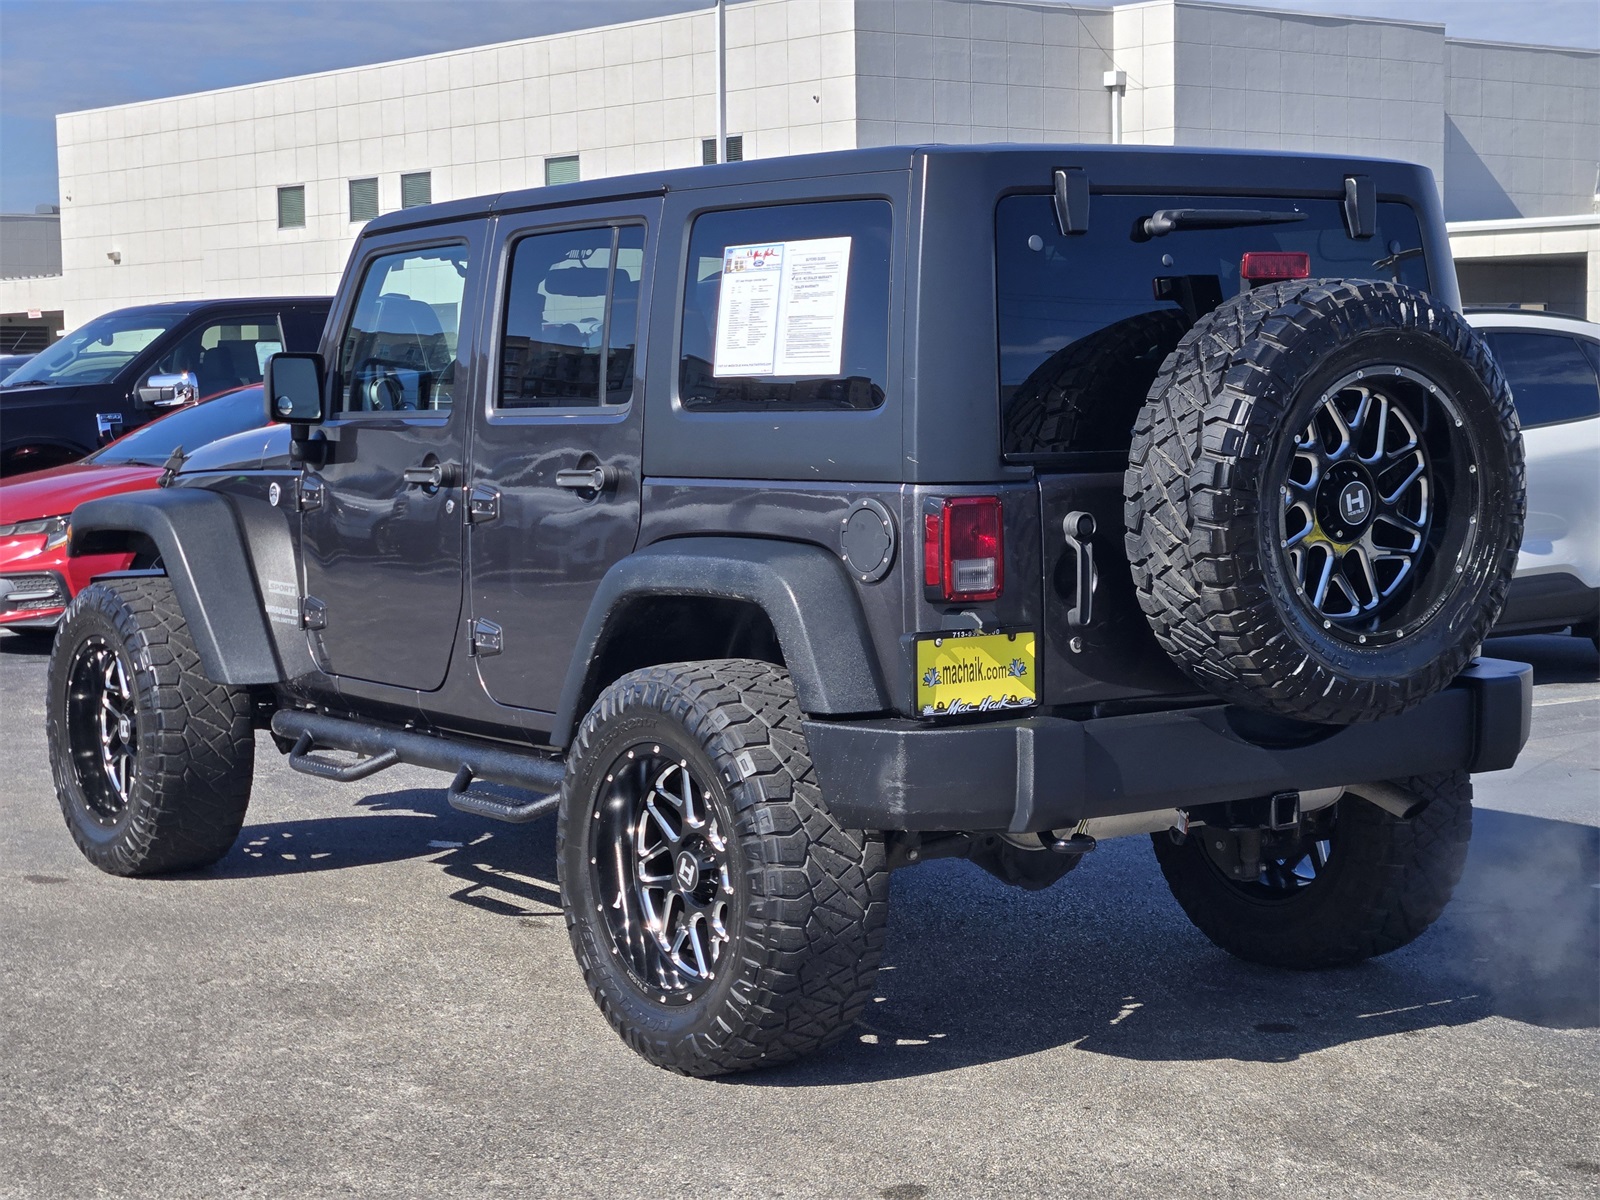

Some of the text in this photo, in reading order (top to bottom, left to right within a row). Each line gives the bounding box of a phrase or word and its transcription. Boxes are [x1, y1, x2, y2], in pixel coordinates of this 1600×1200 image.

[1346, 489, 1364, 512] H
[270, 584, 294, 594] SPORT
[942, 656, 1007, 685] machaik.com
[946, 694, 1009, 715] Mac Haik
[626, 969, 648, 994] HOSTILE
